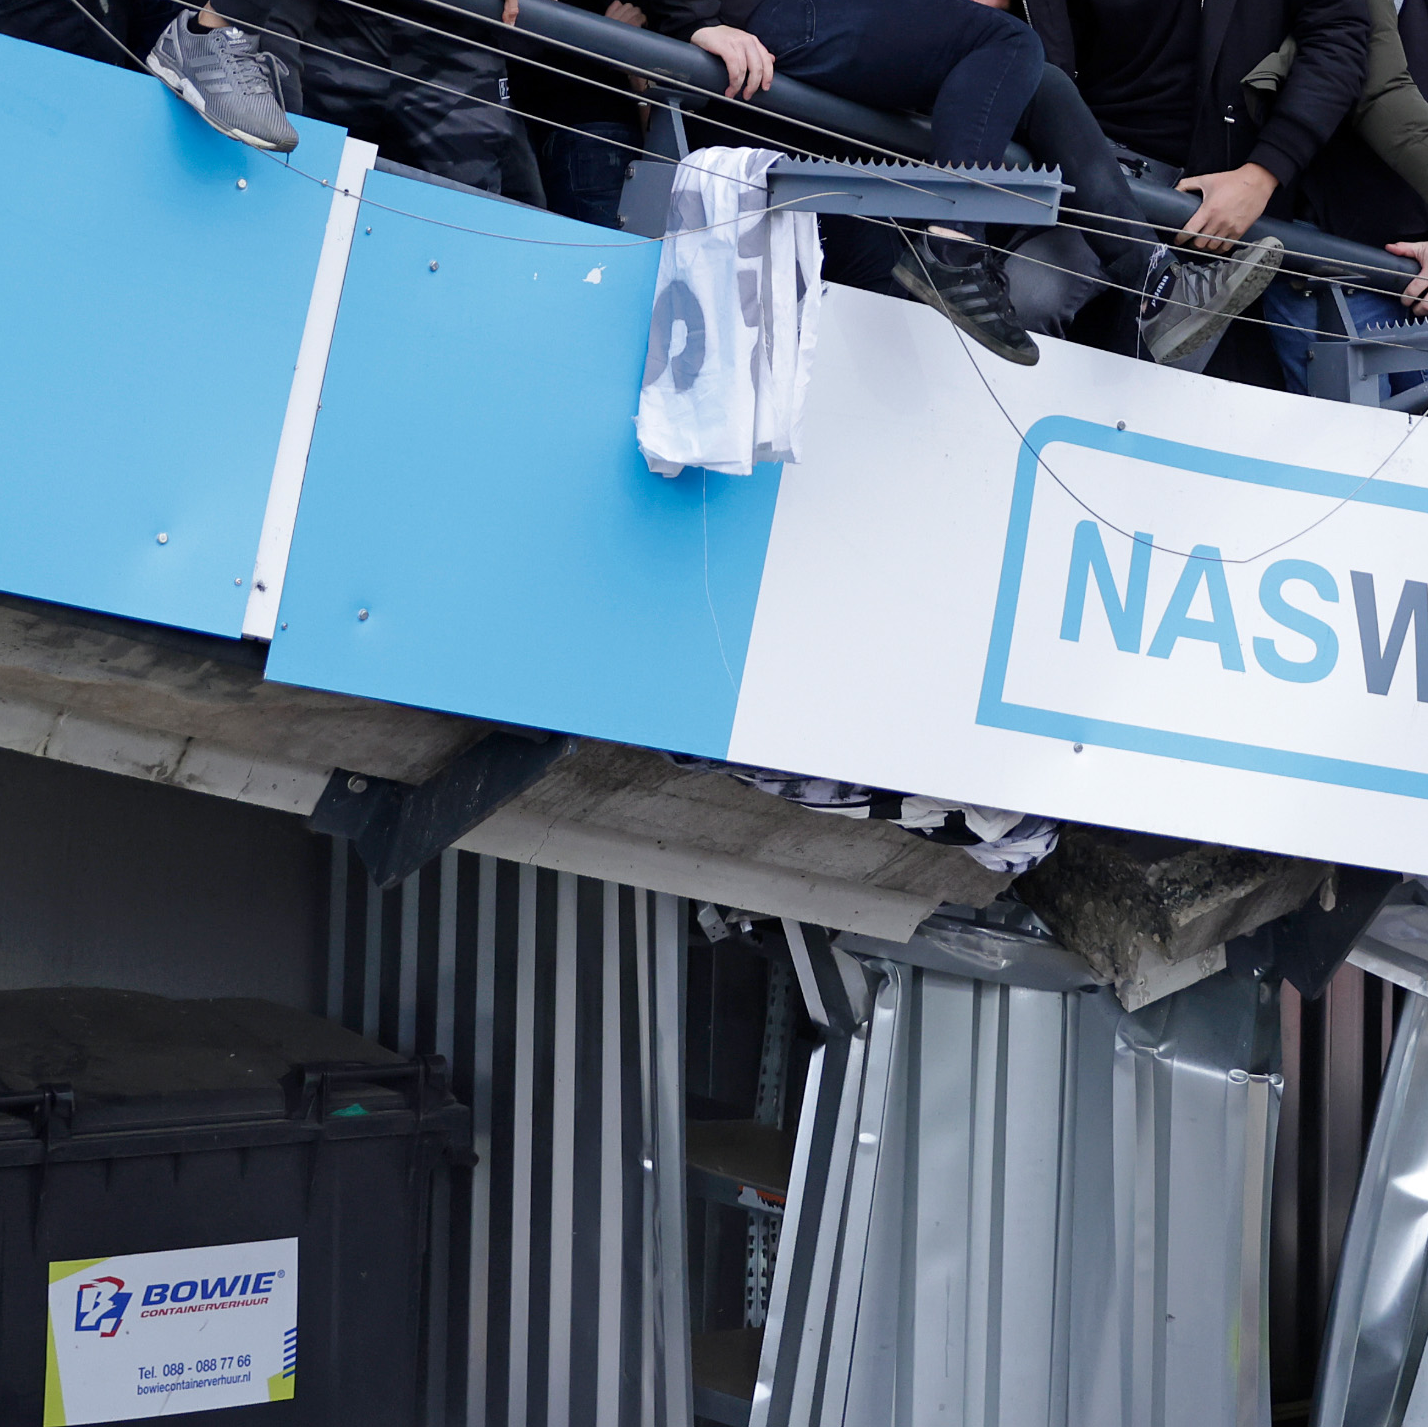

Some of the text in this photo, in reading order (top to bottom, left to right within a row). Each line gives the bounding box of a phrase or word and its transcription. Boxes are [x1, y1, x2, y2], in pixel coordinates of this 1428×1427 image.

[140, 1297, 270, 1319] CONTAINERVERHUUR
[138, 1365, 158, 1381] Tel.
[162, 1361, 185, 1378] 088
[195, 1357, 218, 1375] 088
[220, 1355, 234, 1372] 77
[236, 1352, 251, 1369] 66
[136, 1370, 252, 1397] bowiecontainerverhuur.nl
